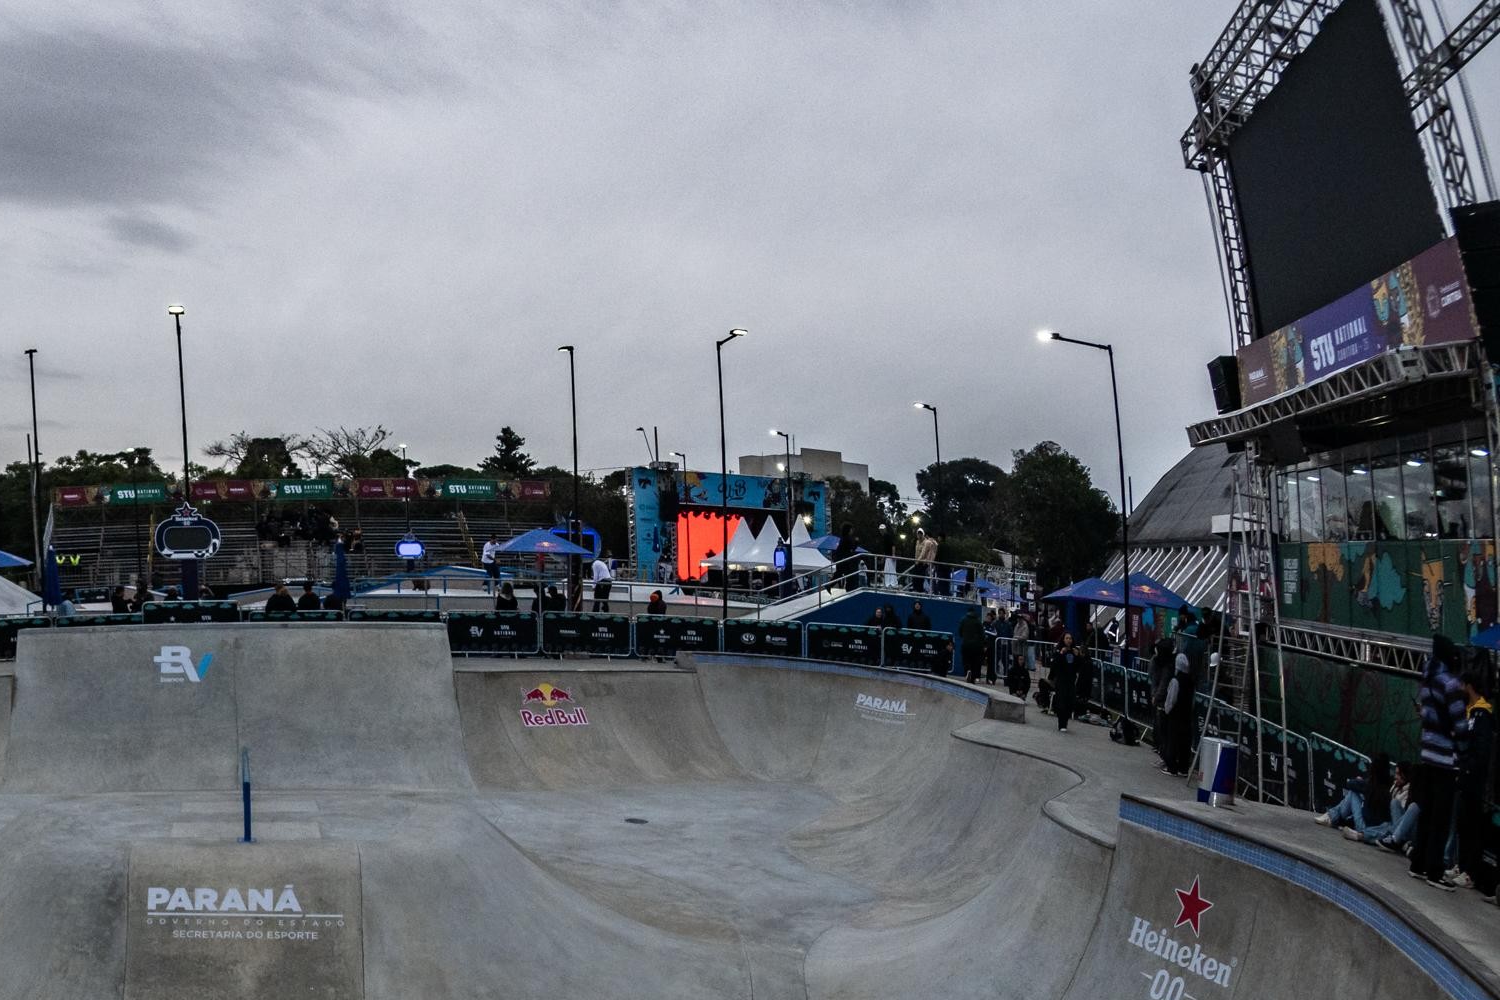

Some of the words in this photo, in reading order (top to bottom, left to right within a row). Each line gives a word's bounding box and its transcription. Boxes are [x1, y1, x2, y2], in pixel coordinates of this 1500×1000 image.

[1334, 316, 1368, 345] NATIONAL
[1310, 332, 1335, 371] STU
[118, 490, 135, 499] STU
[284, 484, 302, 494] STU
[449, 485, 467, 493] STU
[856, 693, 907, 713] PARANÁ
[147, 884, 302, 912] PARANÁ
[146, 918, 229, 926] GOVERNO
[244, 918, 264, 926] DO
[278, 919, 345, 927] ESTADO
[172, 930, 243, 940] SECRETARIA
[246, 931, 264, 940] DO
[267, 931, 319, 941] ESPORTE
